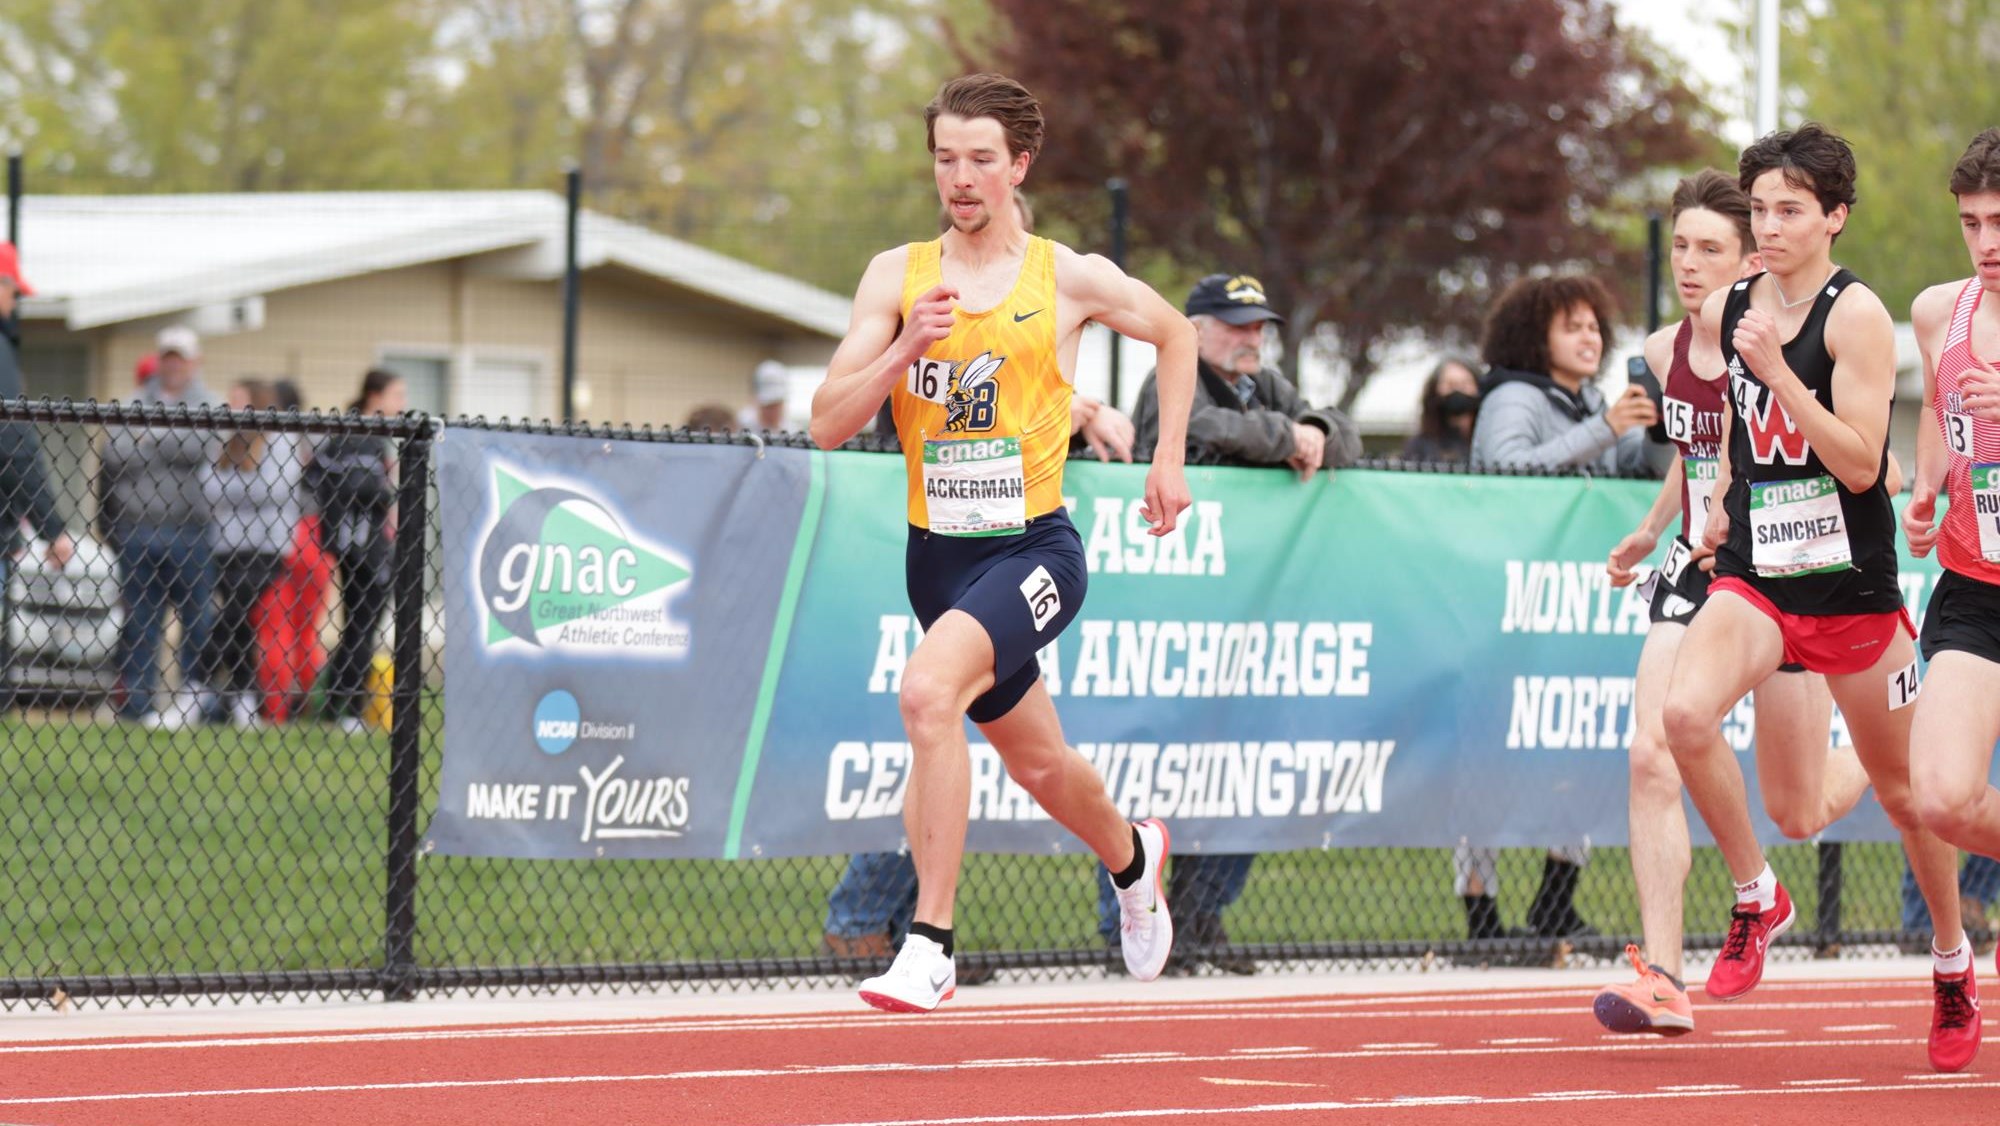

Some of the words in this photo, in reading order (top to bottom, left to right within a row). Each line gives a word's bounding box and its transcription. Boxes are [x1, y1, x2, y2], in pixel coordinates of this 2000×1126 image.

[914, 359, 939, 399] 16
[964, 377, 1000, 433] B
[1666, 402, 1686, 438] 15
[1748, 385, 1817, 466] W
[1946, 415, 1966, 453] 13
[937, 439, 1005, 467] gnac
[927, 477, 1023, 499] ACKERMAN
[1762, 480, 1821, 509] gnac
[1757, 515, 1841, 545] SANCHEZ
[493, 542, 637, 612] gnac
[538, 600, 582, 620] Great
[587, 602, 663, 623] Northwest
[1030, 577, 1057, 619] 16
[558, 625, 618, 646] Athletic
[624, 626, 689, 647] Conference
[1071, 620, 1373, 697] ANCHORAGE
[1896, 663, 1917, 704] 14
[537, 720, 577, 739] NCAA
[581, 722, 625, 739] Division
[467, 782, 540, 820] MAKE
[545, 784, 577, 820] IT
